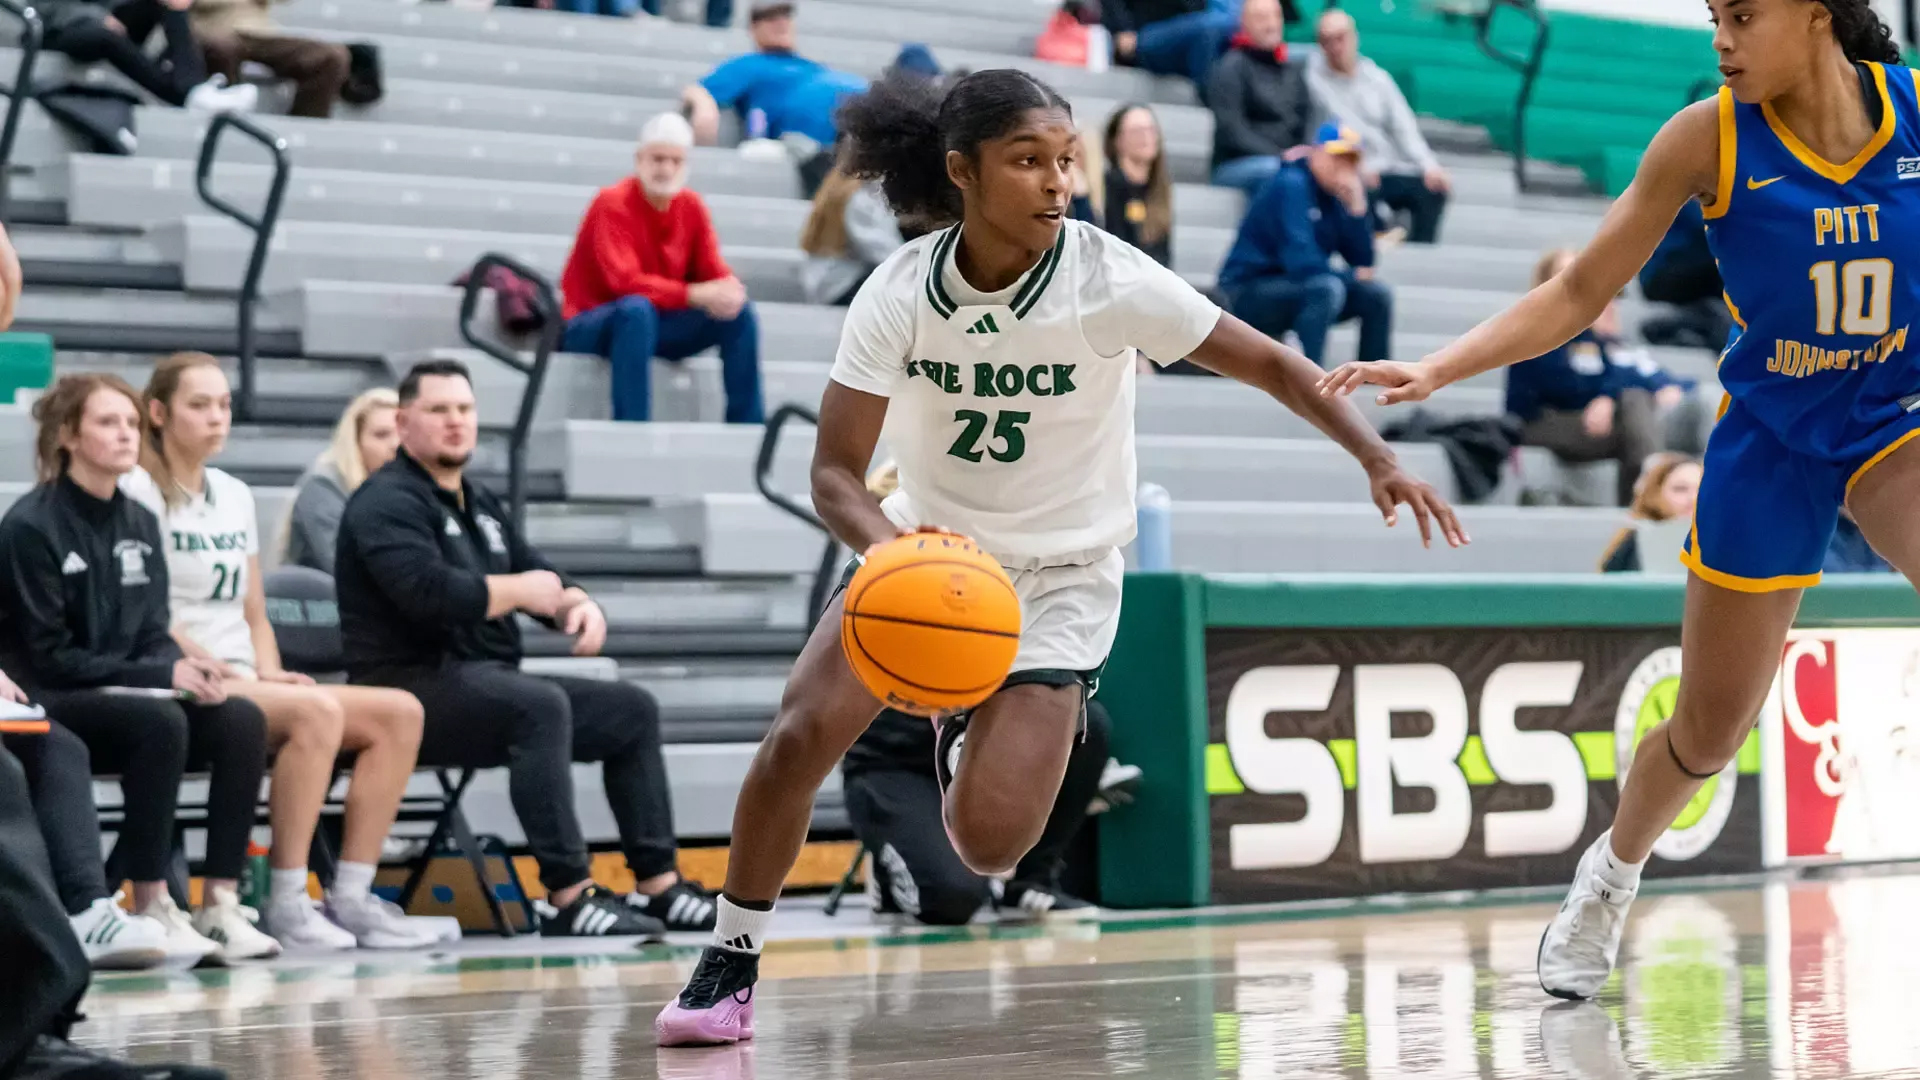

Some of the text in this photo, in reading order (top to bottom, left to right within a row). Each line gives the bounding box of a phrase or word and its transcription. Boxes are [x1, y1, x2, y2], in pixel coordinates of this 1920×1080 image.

[1814, 204, 1879, 246] PITT
[1809, 257, 1894, 336] 10
[973, 362, 1077, 397] ROCK
[947, 409, 1031, 463] 25
[1226, 661, 1588, 870] SBS
